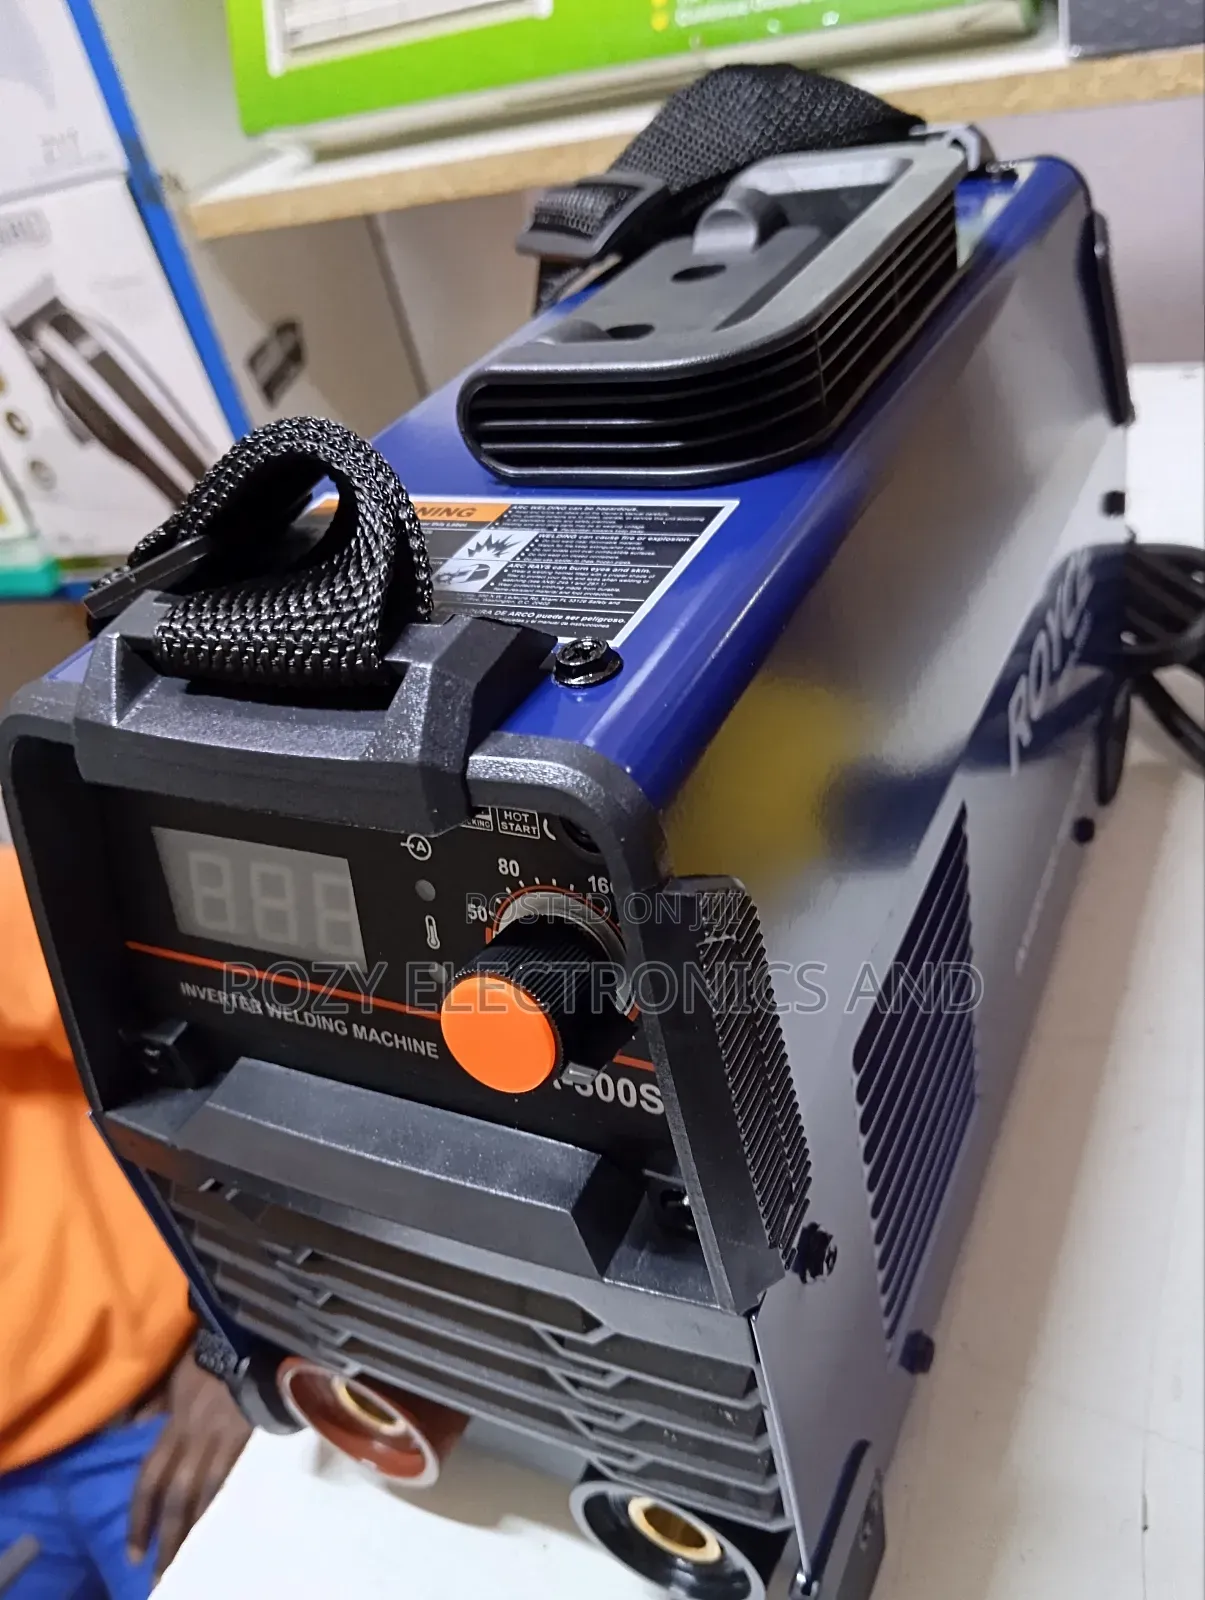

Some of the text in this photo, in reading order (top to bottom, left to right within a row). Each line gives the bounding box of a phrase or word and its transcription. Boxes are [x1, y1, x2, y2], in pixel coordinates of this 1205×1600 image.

[413, 506, 477, 518] NING
[466, 818, 491, 829] KING
[504, 810, 529, 823] HOT
[501, 821, 538, 836] START
[497, 857, 520, 877] 80
[467, 903, 488, 922] 50
[179, 980, 440, 1060] INVERTER WELDING MACHINE
